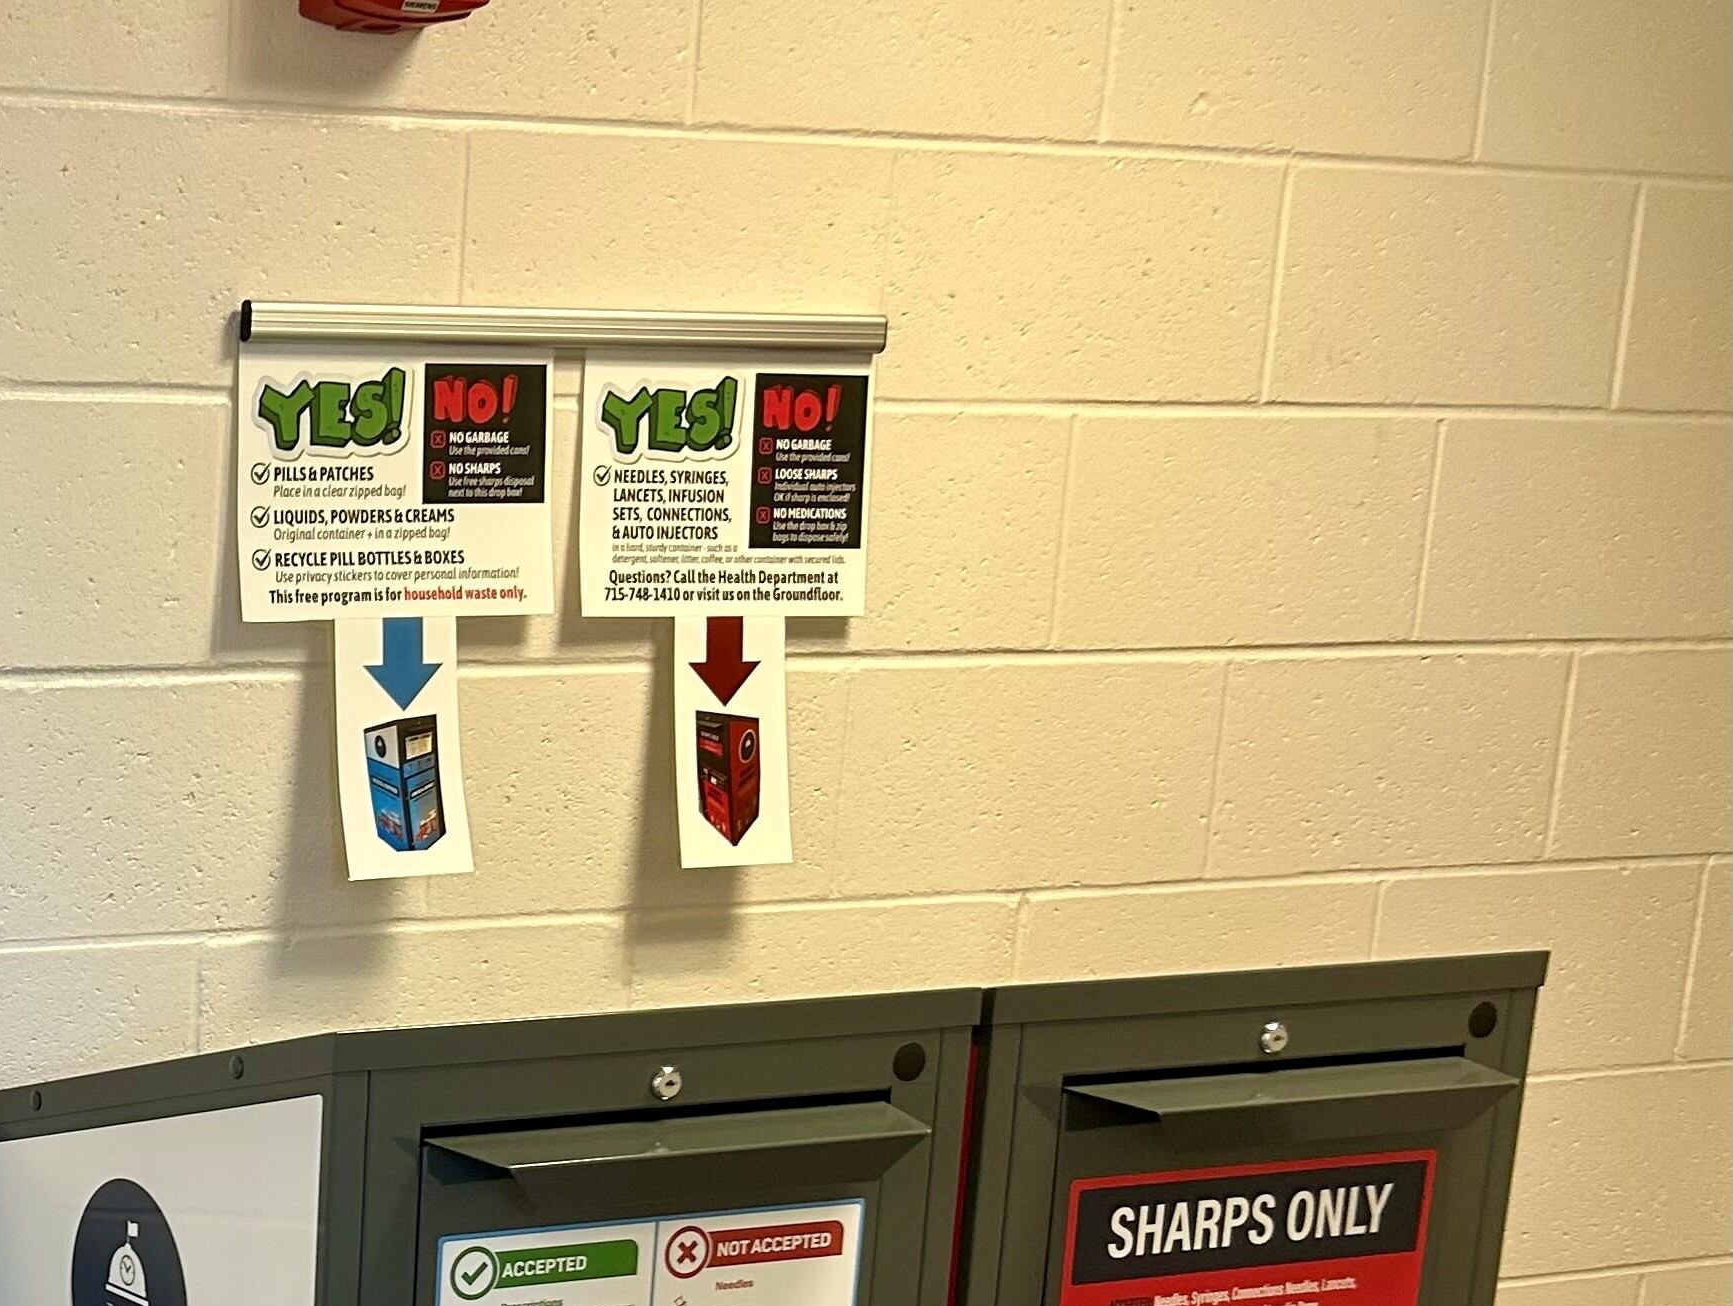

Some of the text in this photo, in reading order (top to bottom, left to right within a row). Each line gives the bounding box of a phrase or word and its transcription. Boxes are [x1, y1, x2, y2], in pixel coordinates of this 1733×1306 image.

[433, 374, 517, 424] NO!
[763, 384, 842, 432] NO!
[258, 367, 406, 450] YES!
[601, 376, 737, 454] YES!
[273, 466, 373, 482] PILLS & PATCHES
[614, 470, 729, 486] NEEDLES, SYRINGES,
[613, 488, 724, 504] LANCETS, INFUSION
[273, 508, 454, 527] LIQUIDS, POWDERS & CREAMS
[612, 507, 732, 523] SETS, CONNECTIONS,
[612, 526, 718, 540] & AUTO INJECTORS
[275, 550, 464, 567] RECYCLE PILL BOTTLES & BOXES
[609, 570, 839, 587] Questions? Call the Health Department at
[605, 587, 843, 601] 715-748-1410 or visit us on the Groundfloor.
[1107, 1182, 1394, 1259] SHARPS ONLY
[717, 1232, 831, 1257] NOT ACCEPTED
[501, 1255, 587, 1278] ACCEPTED
